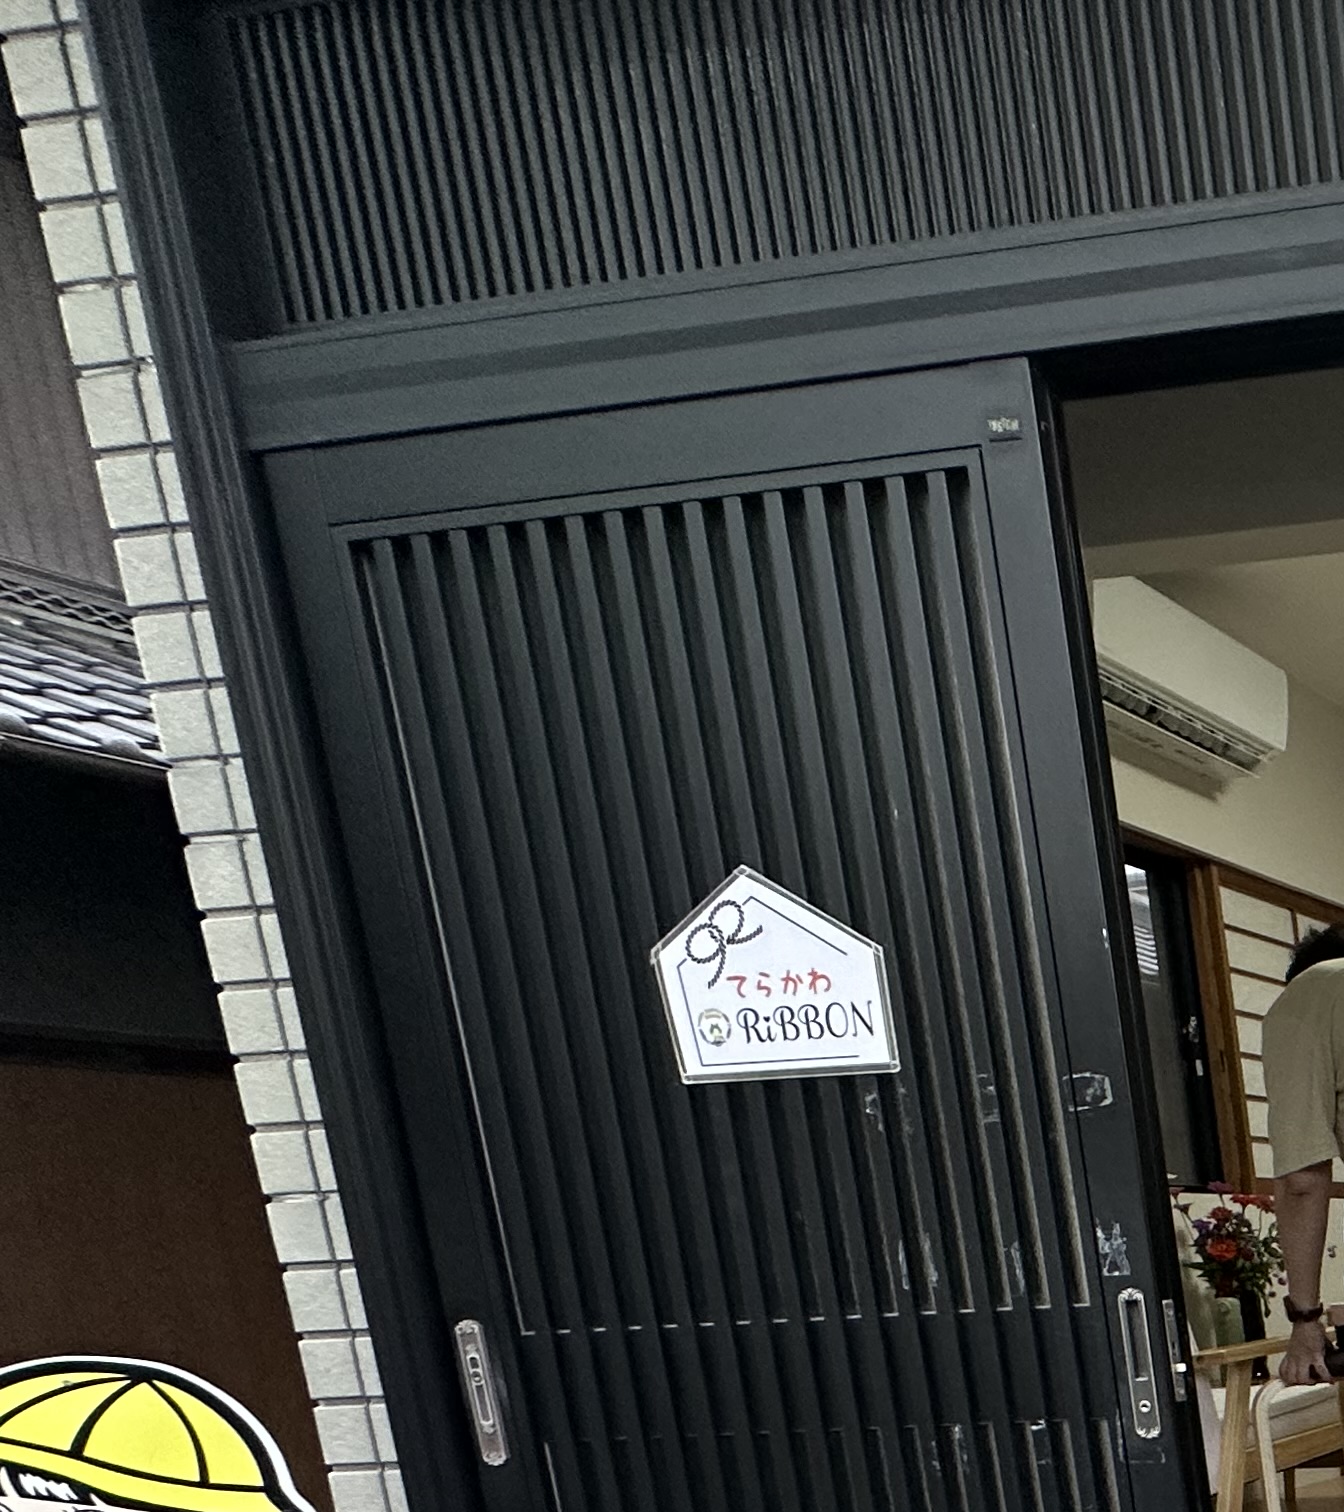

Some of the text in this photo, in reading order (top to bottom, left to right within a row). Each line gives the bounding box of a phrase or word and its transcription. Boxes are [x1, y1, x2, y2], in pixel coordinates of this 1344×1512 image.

[726, 967, 832, 998] てらかわ
[736, 1000, 875, 1044] RiBBON
